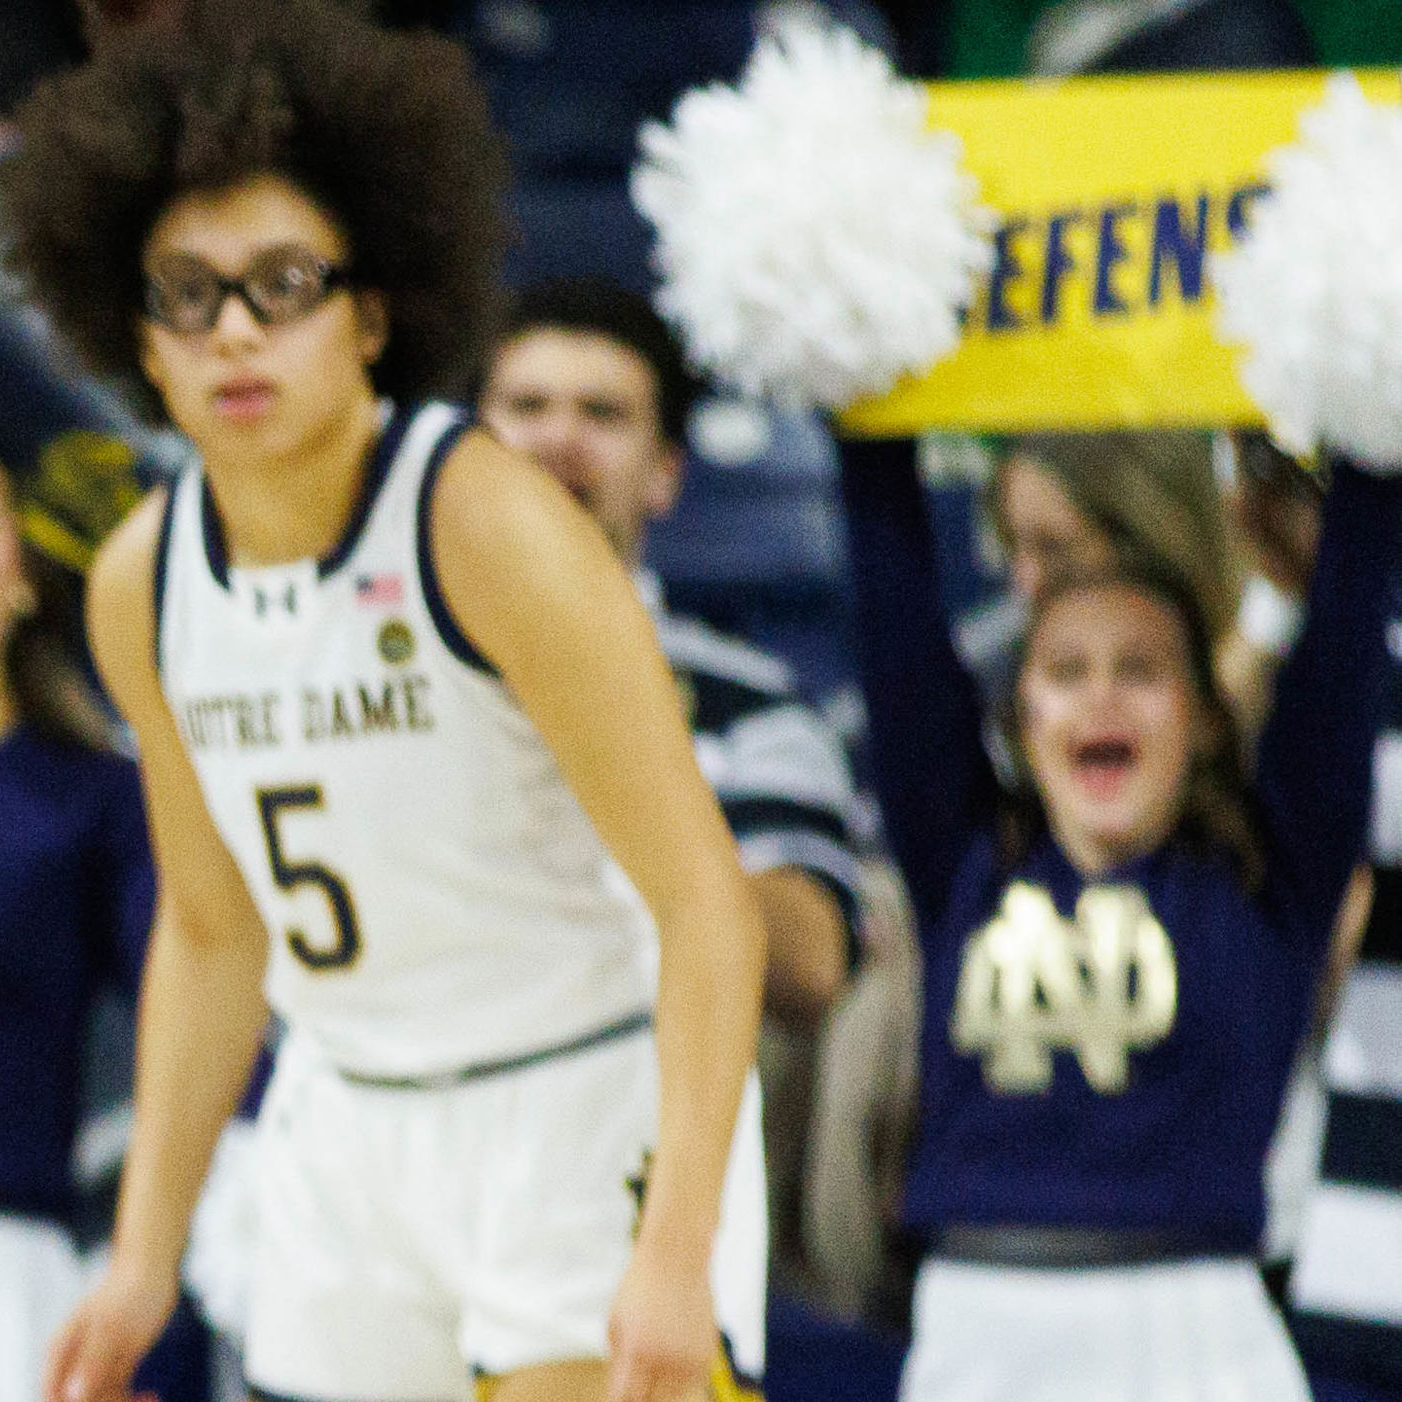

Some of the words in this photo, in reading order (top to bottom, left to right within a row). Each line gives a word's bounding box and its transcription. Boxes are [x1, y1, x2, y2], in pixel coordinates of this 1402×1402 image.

[953, 183, 1273, 331] EFEN
[301, 674, 434, 742] DAME
[254, 782, 363, 972] 5
